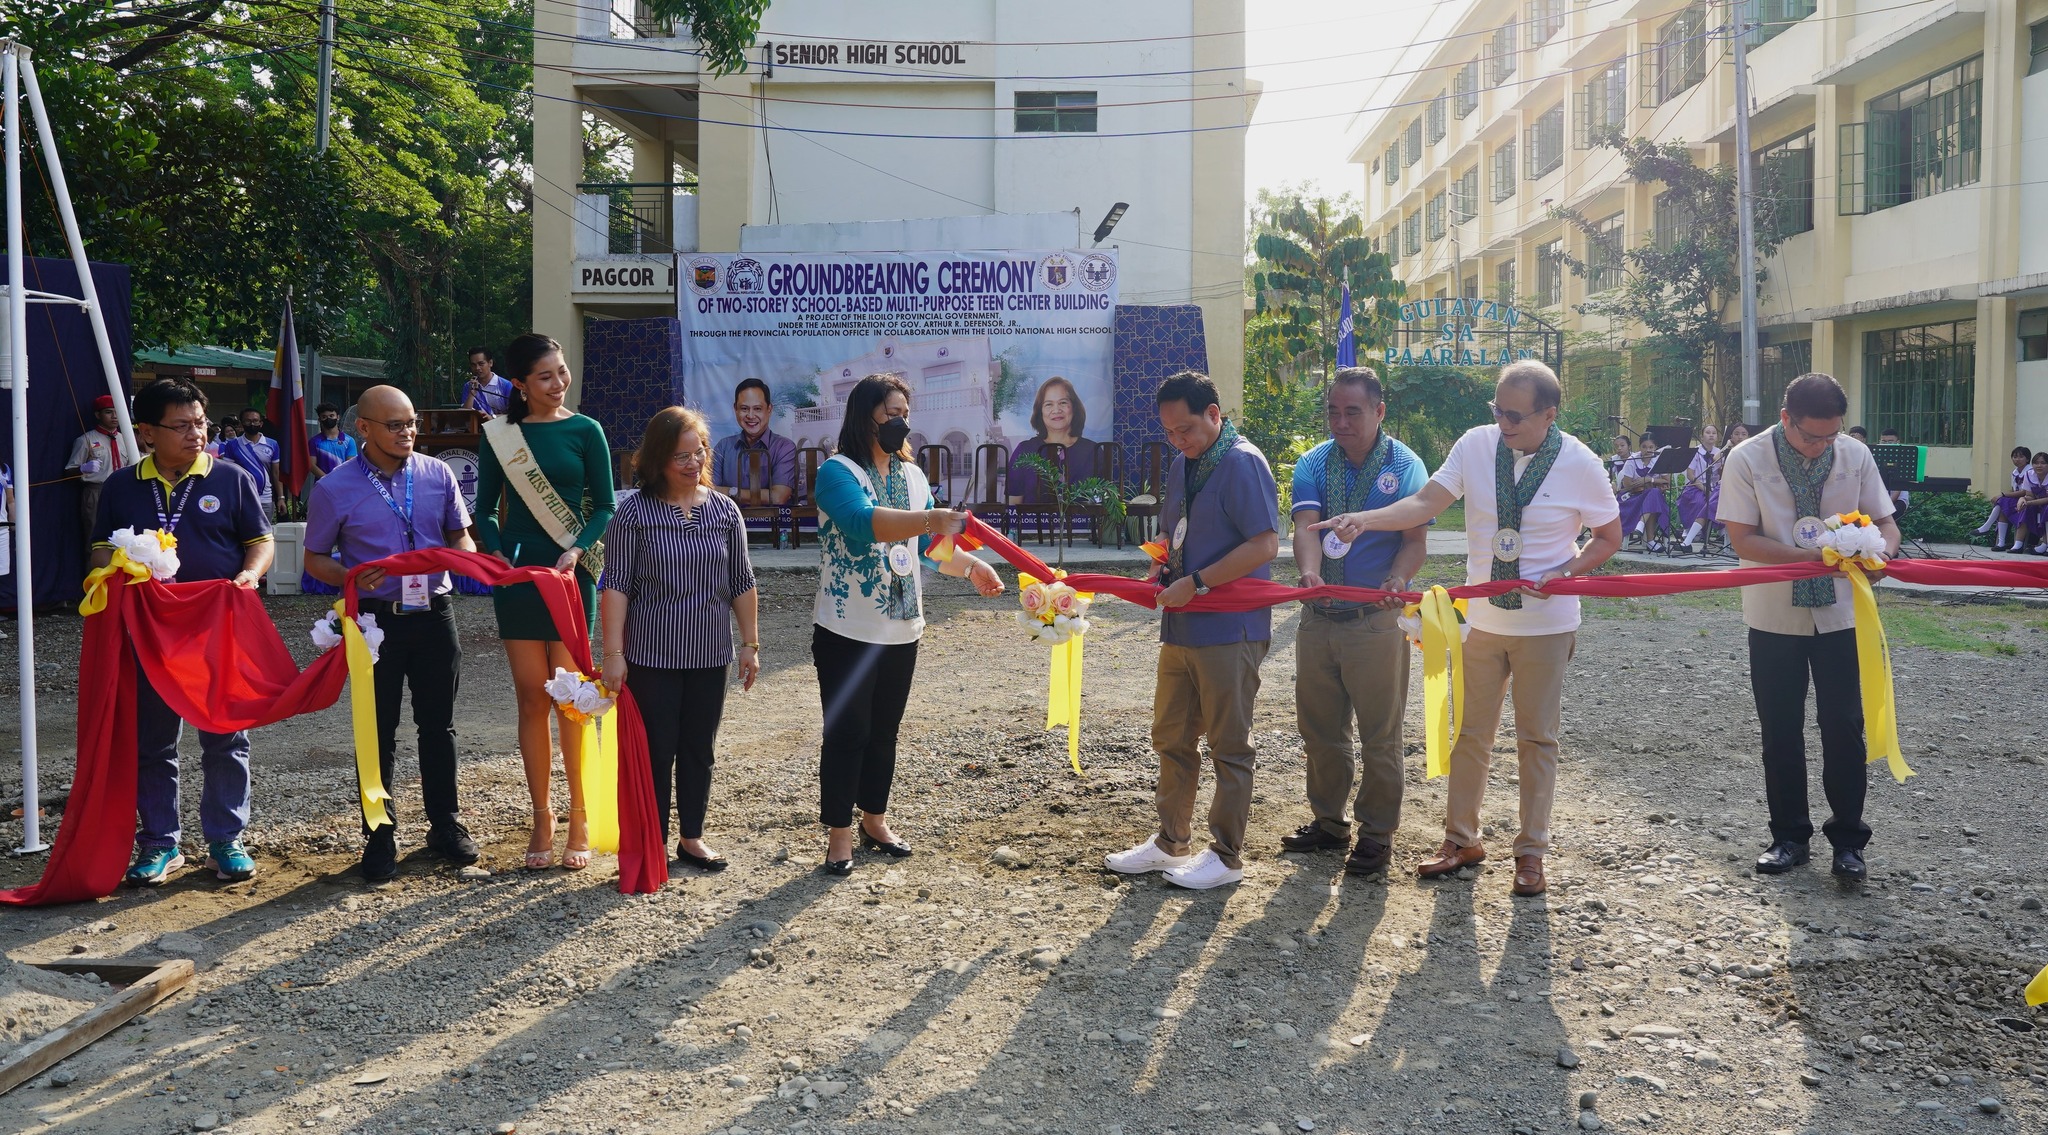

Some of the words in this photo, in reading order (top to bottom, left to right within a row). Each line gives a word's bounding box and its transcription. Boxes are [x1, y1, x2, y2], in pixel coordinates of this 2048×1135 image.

[775, 45, 839, 65] SENIOR
[846, 45, 887, 64] HIGH
[894, 44, 966, 65] SCHOOL
[582, 268, 655, 286] PAGCOR
[768, 262, 930, 296] GROUNDBREAKING
[938, 260, 1036, 294] CEREMONY
[698, 297, 713, 314] OF
[716, 297, 789, 313] TWO-STOREY
[792, 296, 883, 313] SCHOOL-BASED
[886, 295, 974, 312] MULTI-PURPOSE
[976, 295, 1004, 311] TEEN
[1007, 294, 1051, 311] CENTER
[1054, 294, 1109, 310] BUILDING
[1399, 298, 1522, 327] GULAYAN
[944, 312, 1001, 320] GOVERNMENT,
[964, 320, 1006, 328] DEFENSOR,
[1015, 327, 1054, 335] NATIONAL
[1442, 323, 1474, 342] SA
[1384, 346, 1533, 366] PAARALAN
[436, 450, 461, 461] IONAL
[370, 474, 388, 496] ILOILO
[524, 467, 549, 494] MISS
[151, 480, 164, 511] OVERNMENT
